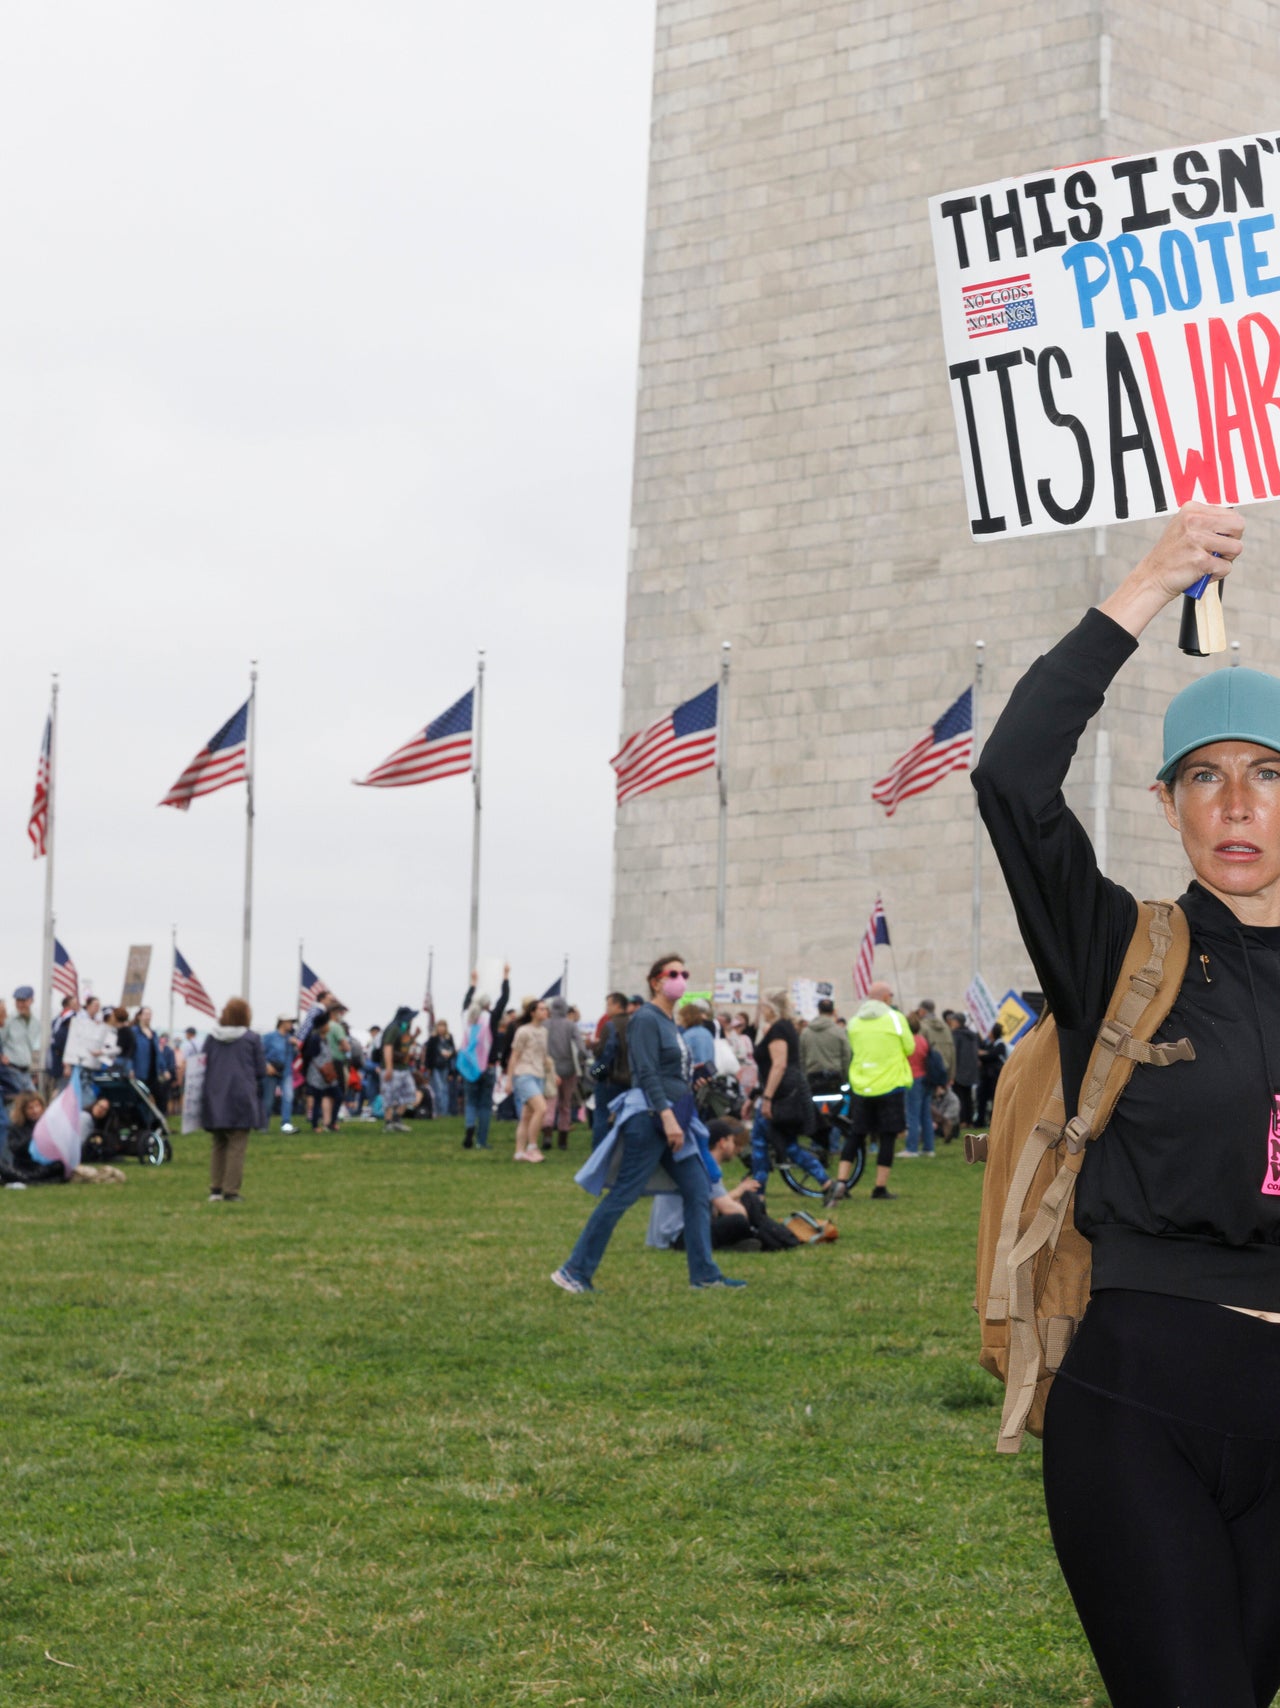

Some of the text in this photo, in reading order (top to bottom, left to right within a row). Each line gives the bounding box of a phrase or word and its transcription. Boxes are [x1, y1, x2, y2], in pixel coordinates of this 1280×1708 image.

[941, 170, 1103, 269] THIS
[966, 286, 1029, 309] NO GODS
[969, 306, 1032, 329] NO KINGS
[949, 346, 1095, 535] IT'S
[1105, 331, 1168, 519] A
